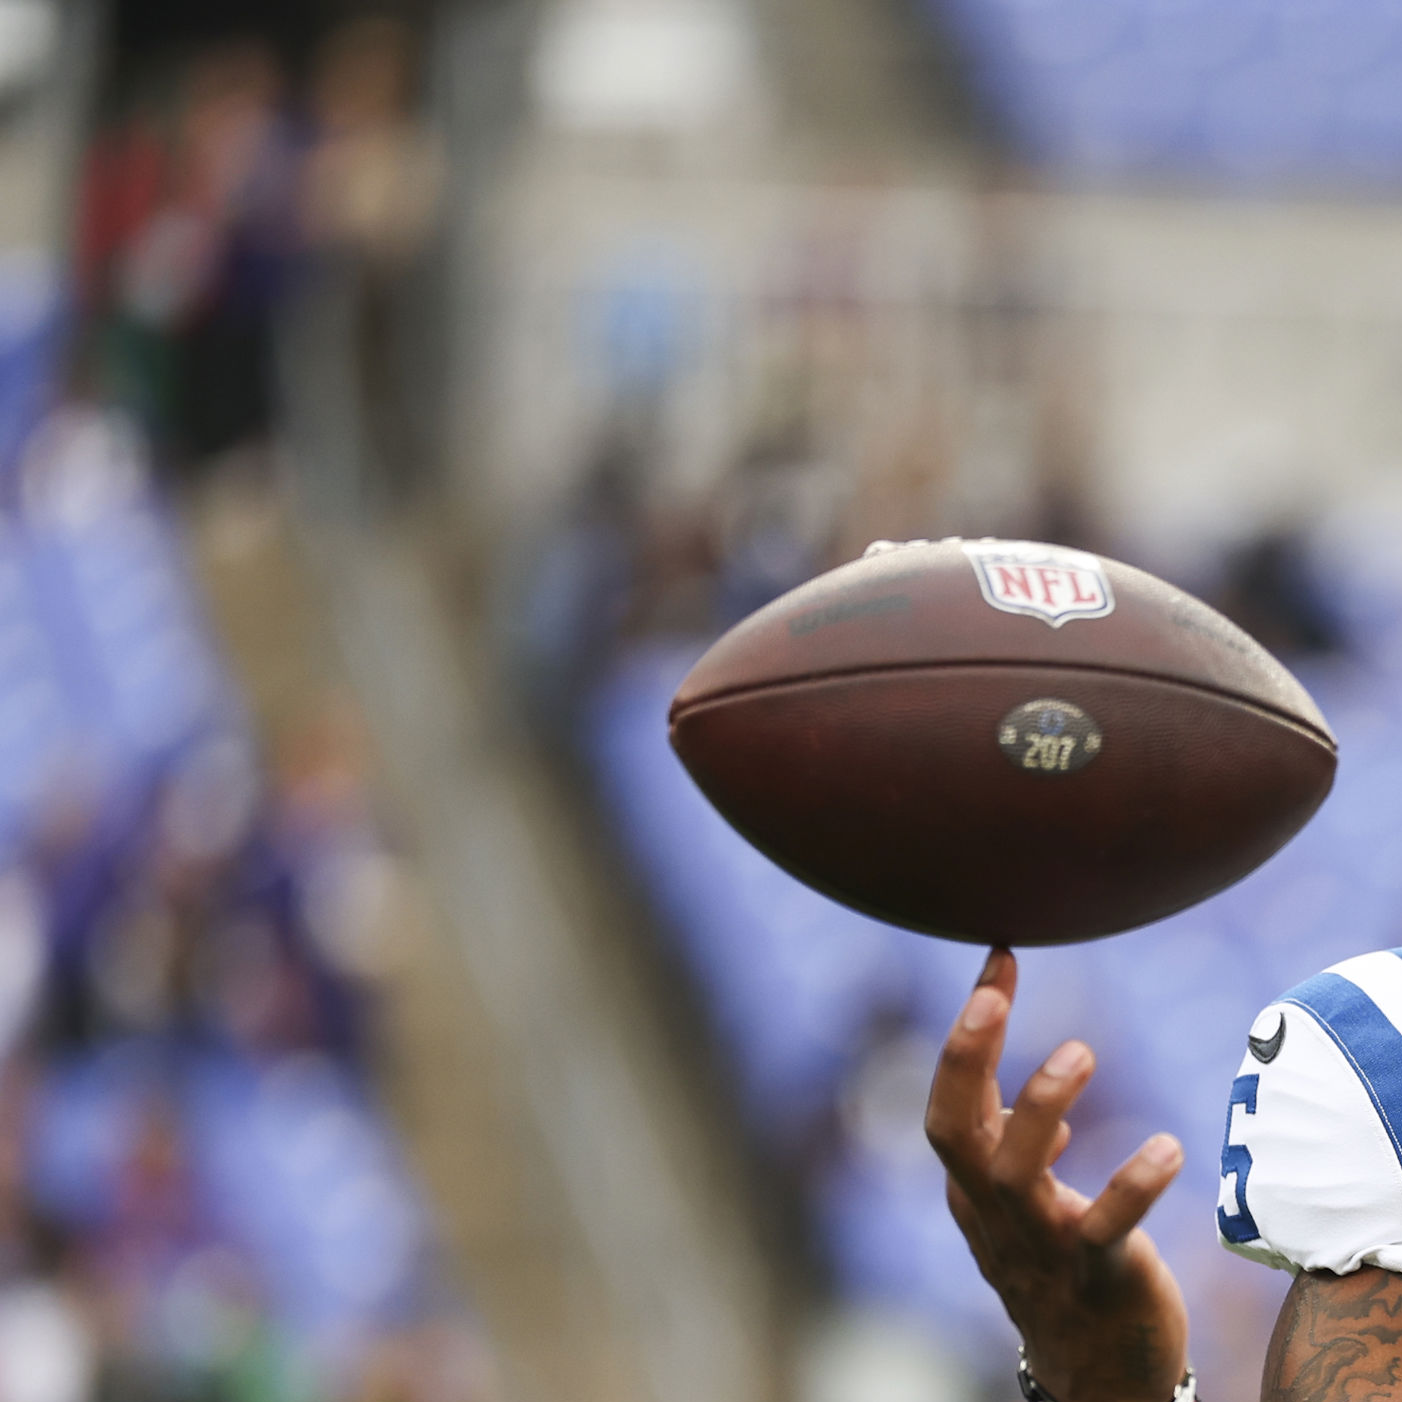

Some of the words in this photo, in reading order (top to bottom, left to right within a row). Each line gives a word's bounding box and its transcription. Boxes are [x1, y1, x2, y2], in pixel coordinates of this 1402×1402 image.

[994, 565, 1098, 608] NFL
[1022, 733, 1077, 770] 207
[1216, 1073, 1262, 1244] 5
